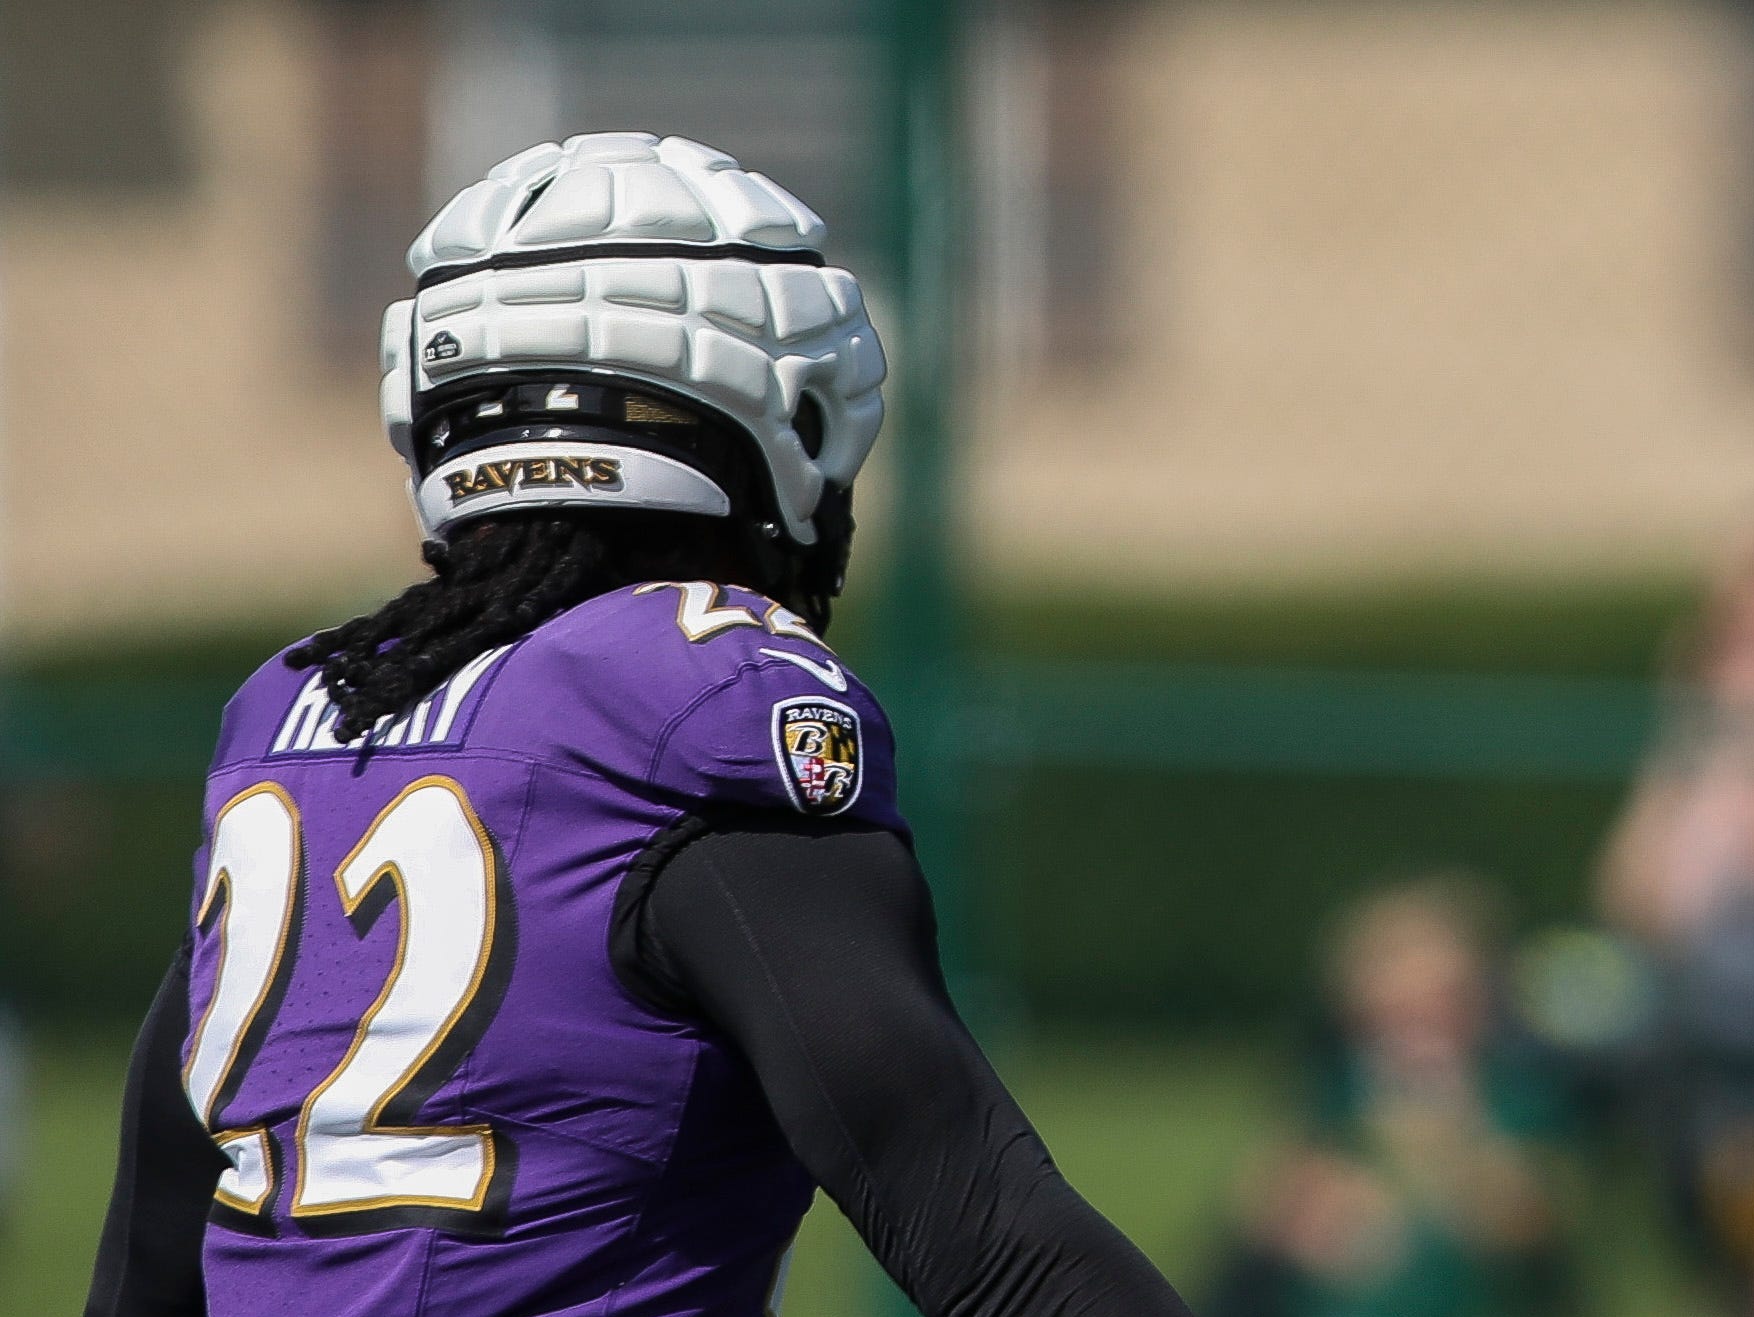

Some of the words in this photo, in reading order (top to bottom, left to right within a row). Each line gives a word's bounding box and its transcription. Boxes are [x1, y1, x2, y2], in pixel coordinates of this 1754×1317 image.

[442, 456, 625, 502] RAVENS
[785, 707, 853, 730] RAVENS
[787, 724, 829, 757] B
[182, 774, 497, 1218] 22
